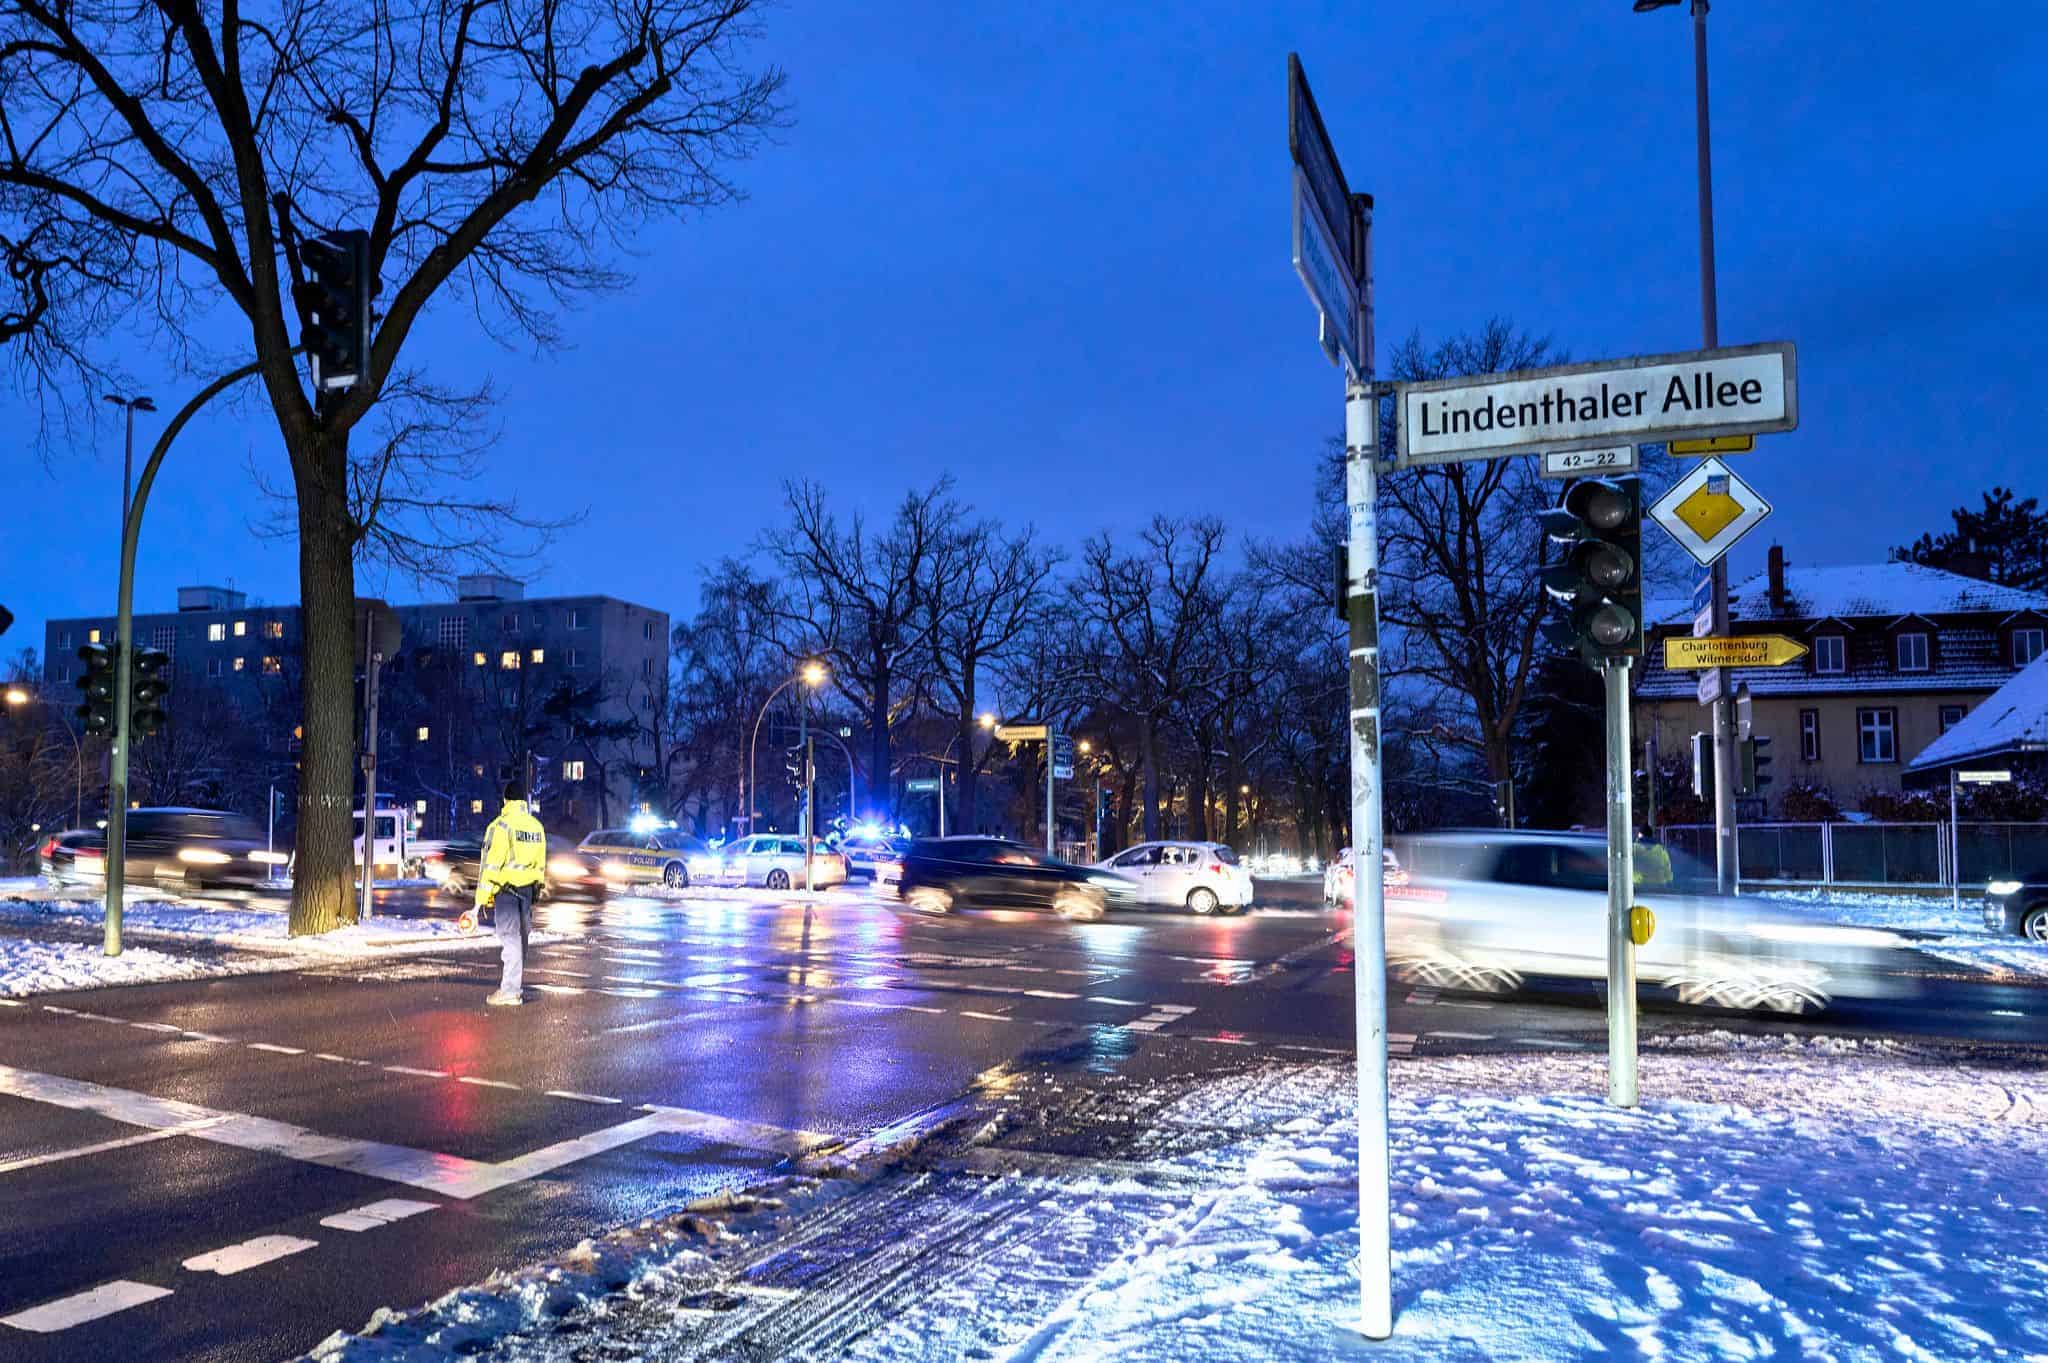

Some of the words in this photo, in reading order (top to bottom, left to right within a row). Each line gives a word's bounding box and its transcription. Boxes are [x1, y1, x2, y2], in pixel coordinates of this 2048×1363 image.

[1421, 383, 1648, 437] Lindenthaler
[1661, 371, 1763, 414] Allee
[1681, 641, 1768, 652] Charlottenburg
[1696, 653, 1768, 664] Wilmersdorf
[632, 855, 657, 865] POLIZEI
